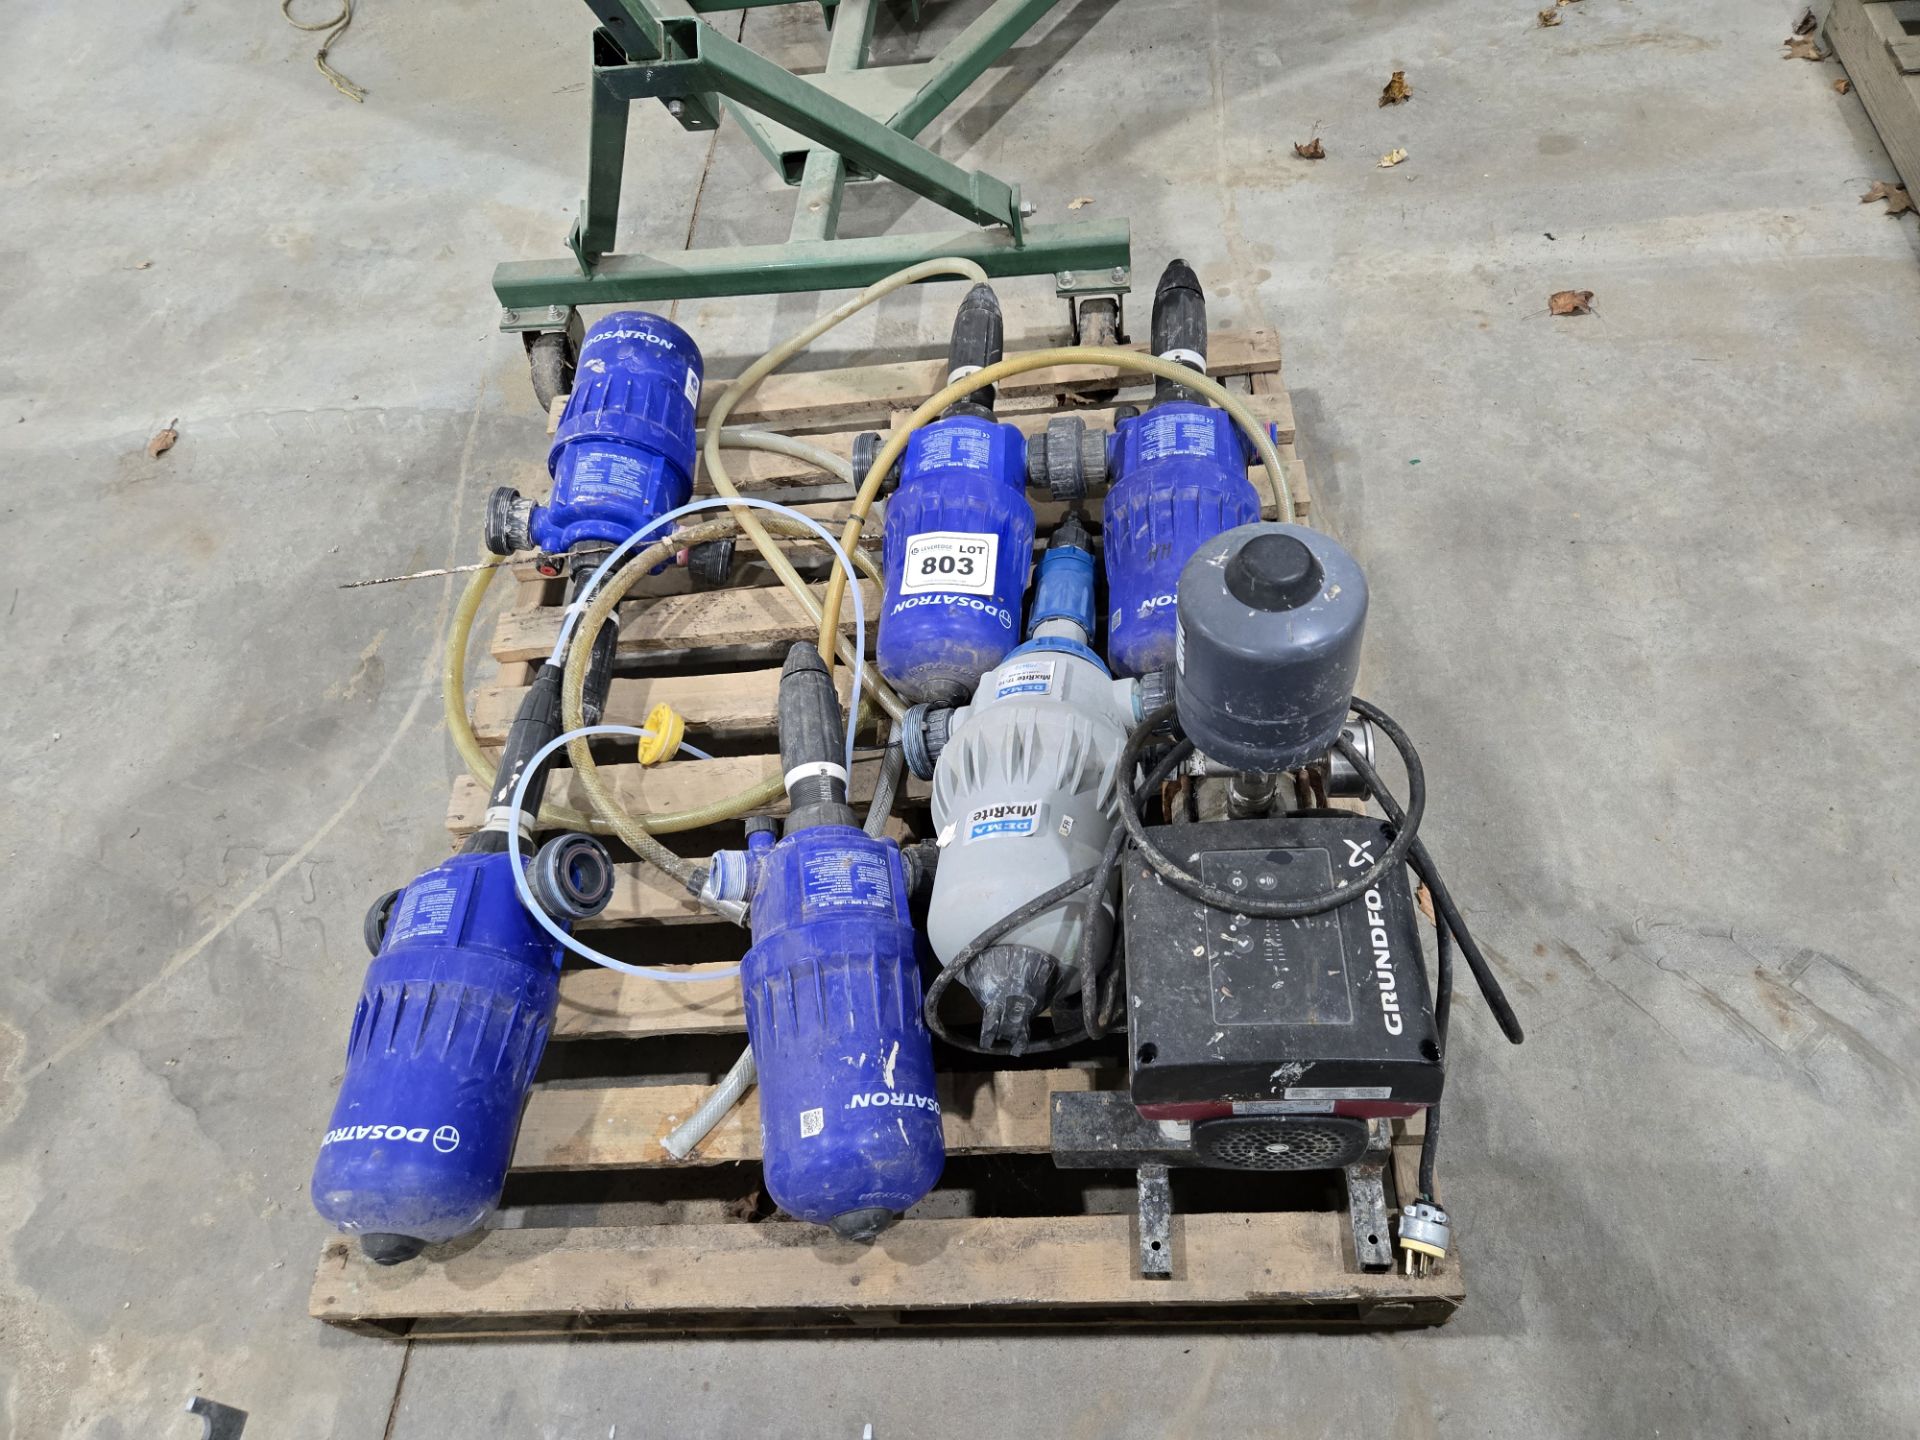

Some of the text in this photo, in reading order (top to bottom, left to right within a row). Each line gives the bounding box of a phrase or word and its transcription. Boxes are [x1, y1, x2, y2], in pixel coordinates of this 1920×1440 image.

[959, 545, 985, 555] LOT
[921, 555, 974, 575] 803
[892, 594, 998, 616] DOSATRON
[1000, 685, 1044, 696] DEMA
[973, 803, 1037, 821] MixRite
[974, 821, 1029, 835] DEMA
[1364, 882, 1404, 1036] GRUNDFO
[849, 1092, 941, 1116] OSATRON
